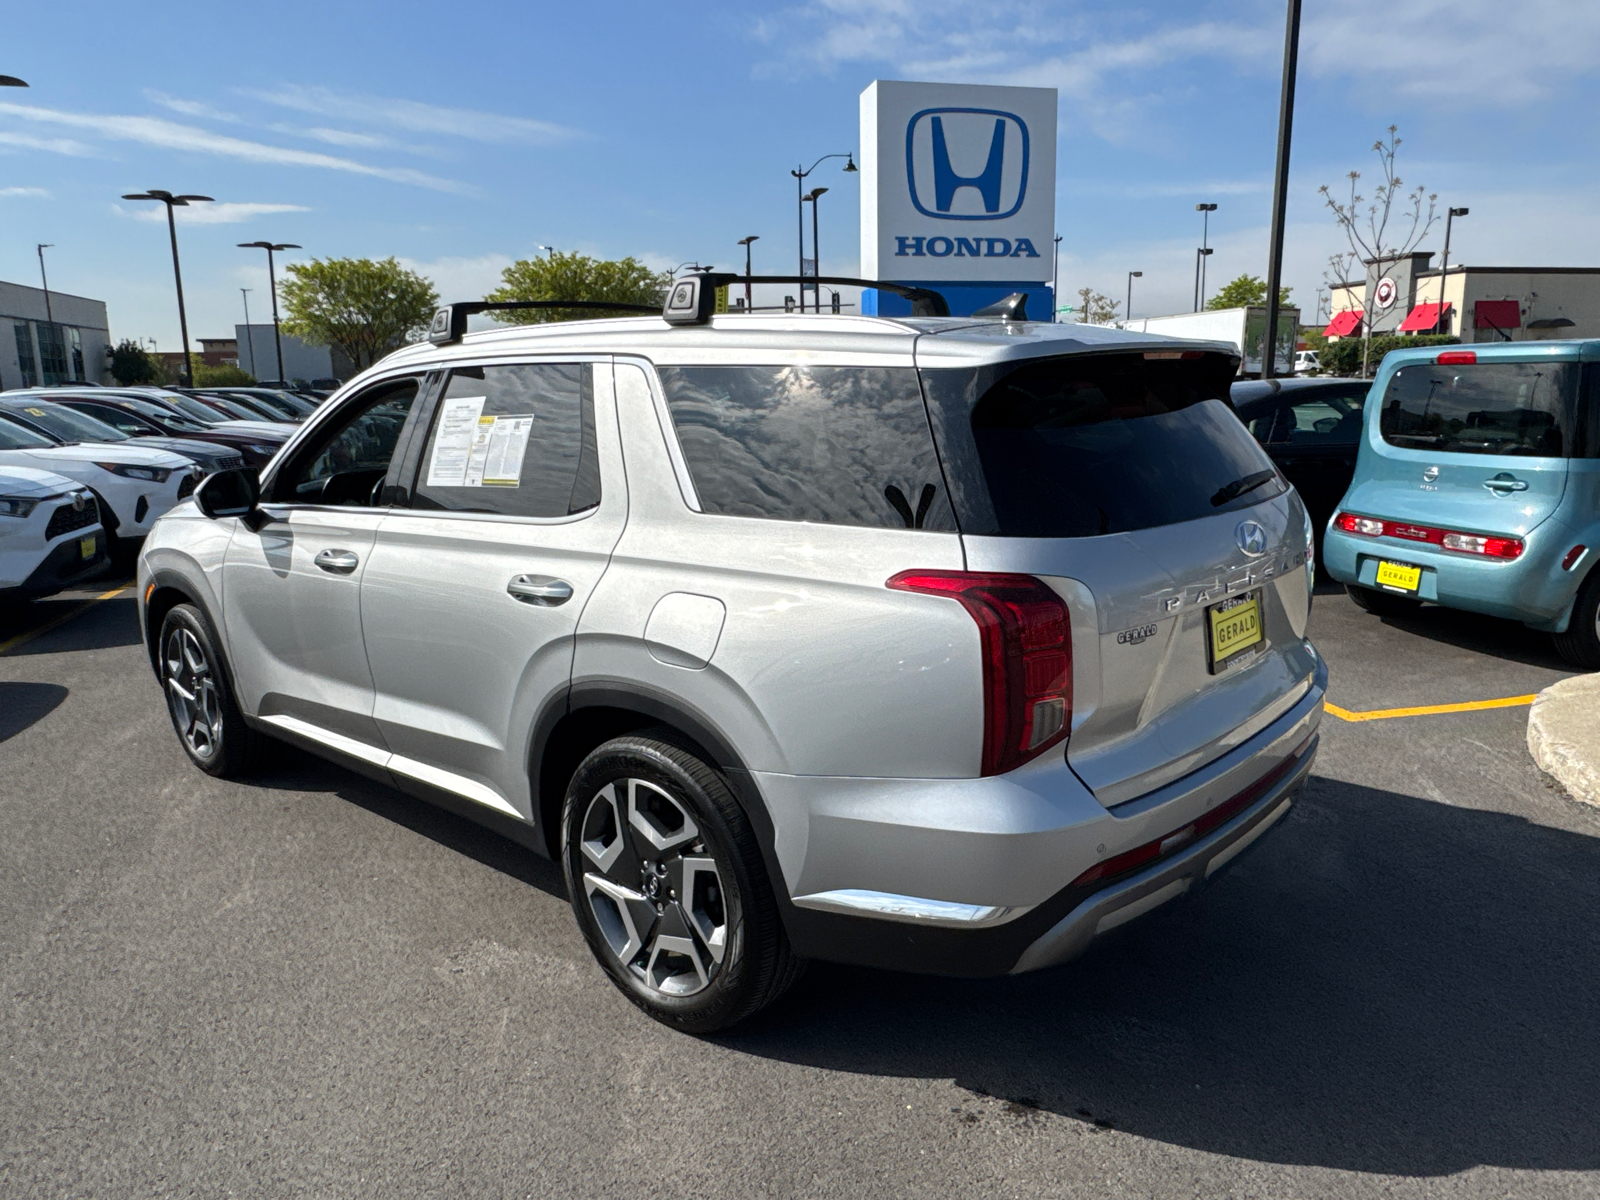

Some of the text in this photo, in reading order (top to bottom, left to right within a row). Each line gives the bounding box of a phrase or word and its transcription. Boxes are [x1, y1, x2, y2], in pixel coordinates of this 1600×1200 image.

[895, 236, 1041, 258] HONDA
[1383, 570, 1414, 583] GERALD
[1117, 623, 1157, 644] GERALD
[1219, 614, 1256, 643] GERALD
